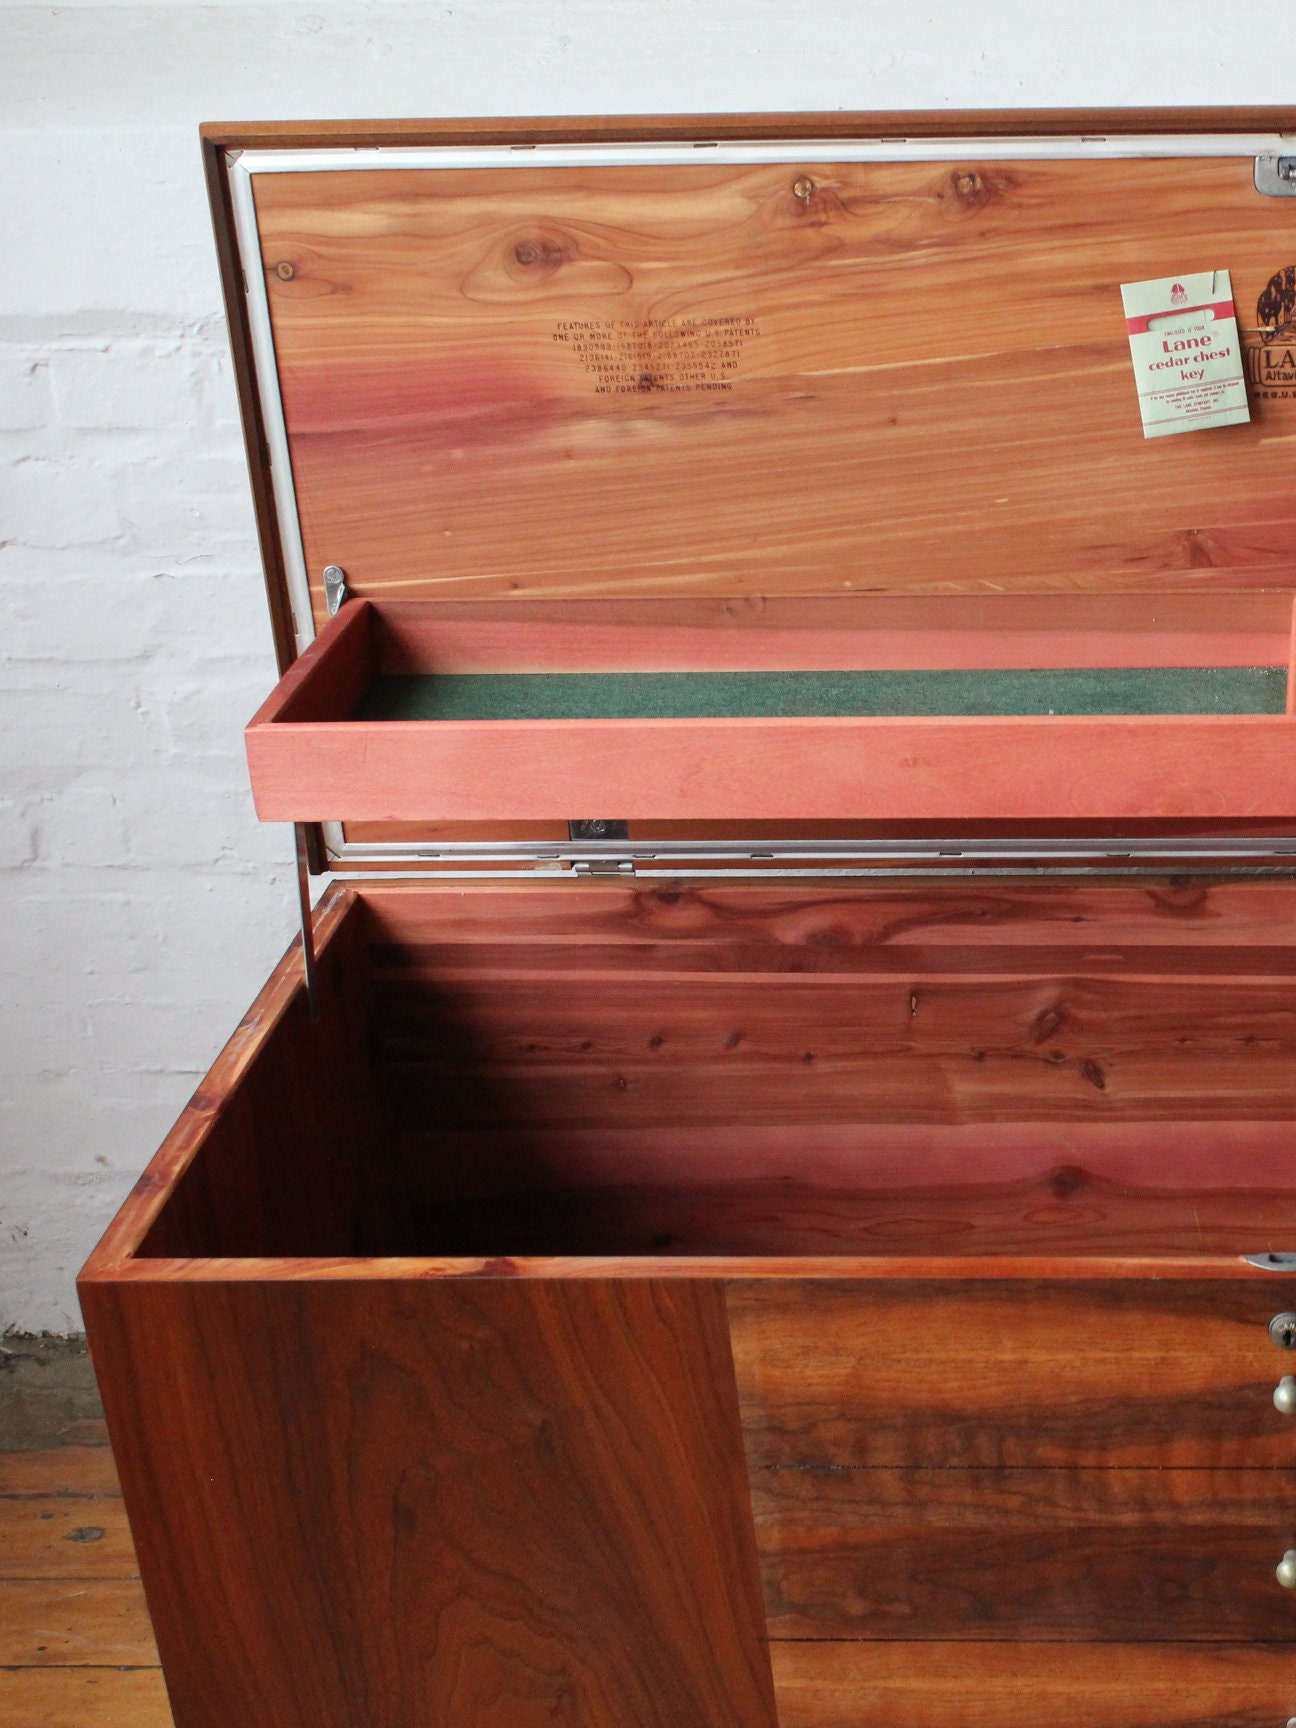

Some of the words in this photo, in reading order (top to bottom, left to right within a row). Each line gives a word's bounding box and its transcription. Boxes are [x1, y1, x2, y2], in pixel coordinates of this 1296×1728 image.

[557, 322, 600, 330] FEATURES
[643, 320, 677, 328] ARTICLE
[681, 319, 697, 327] ARE
[745, 317, 755, 325] BY
[552, 333, 569, 341] ONE
[573, 333, 584, 341] OR
[589, 332, 612, 340] MORE
[632, 331, 649, 339] THE
[724, 328, 760, 337] PATENTS
[1162, 334, 1212, 353] Lane
[721, 361, 738, 369] AND
[1149, 355, 1191, 371] cedar
[1193, 348, 1231, 364] chest
[599, 374, 635, 383] FOREIGN
[680, 372, 705, 380] OTHER
[1181, 368, 1205, 381] key
[595, 385, 611, 393] AND
[616, 385, 651, 393] FOREIGN
[656, 384, 691, 392] PATENTS
[696, 383, 732, 391] PENDING
